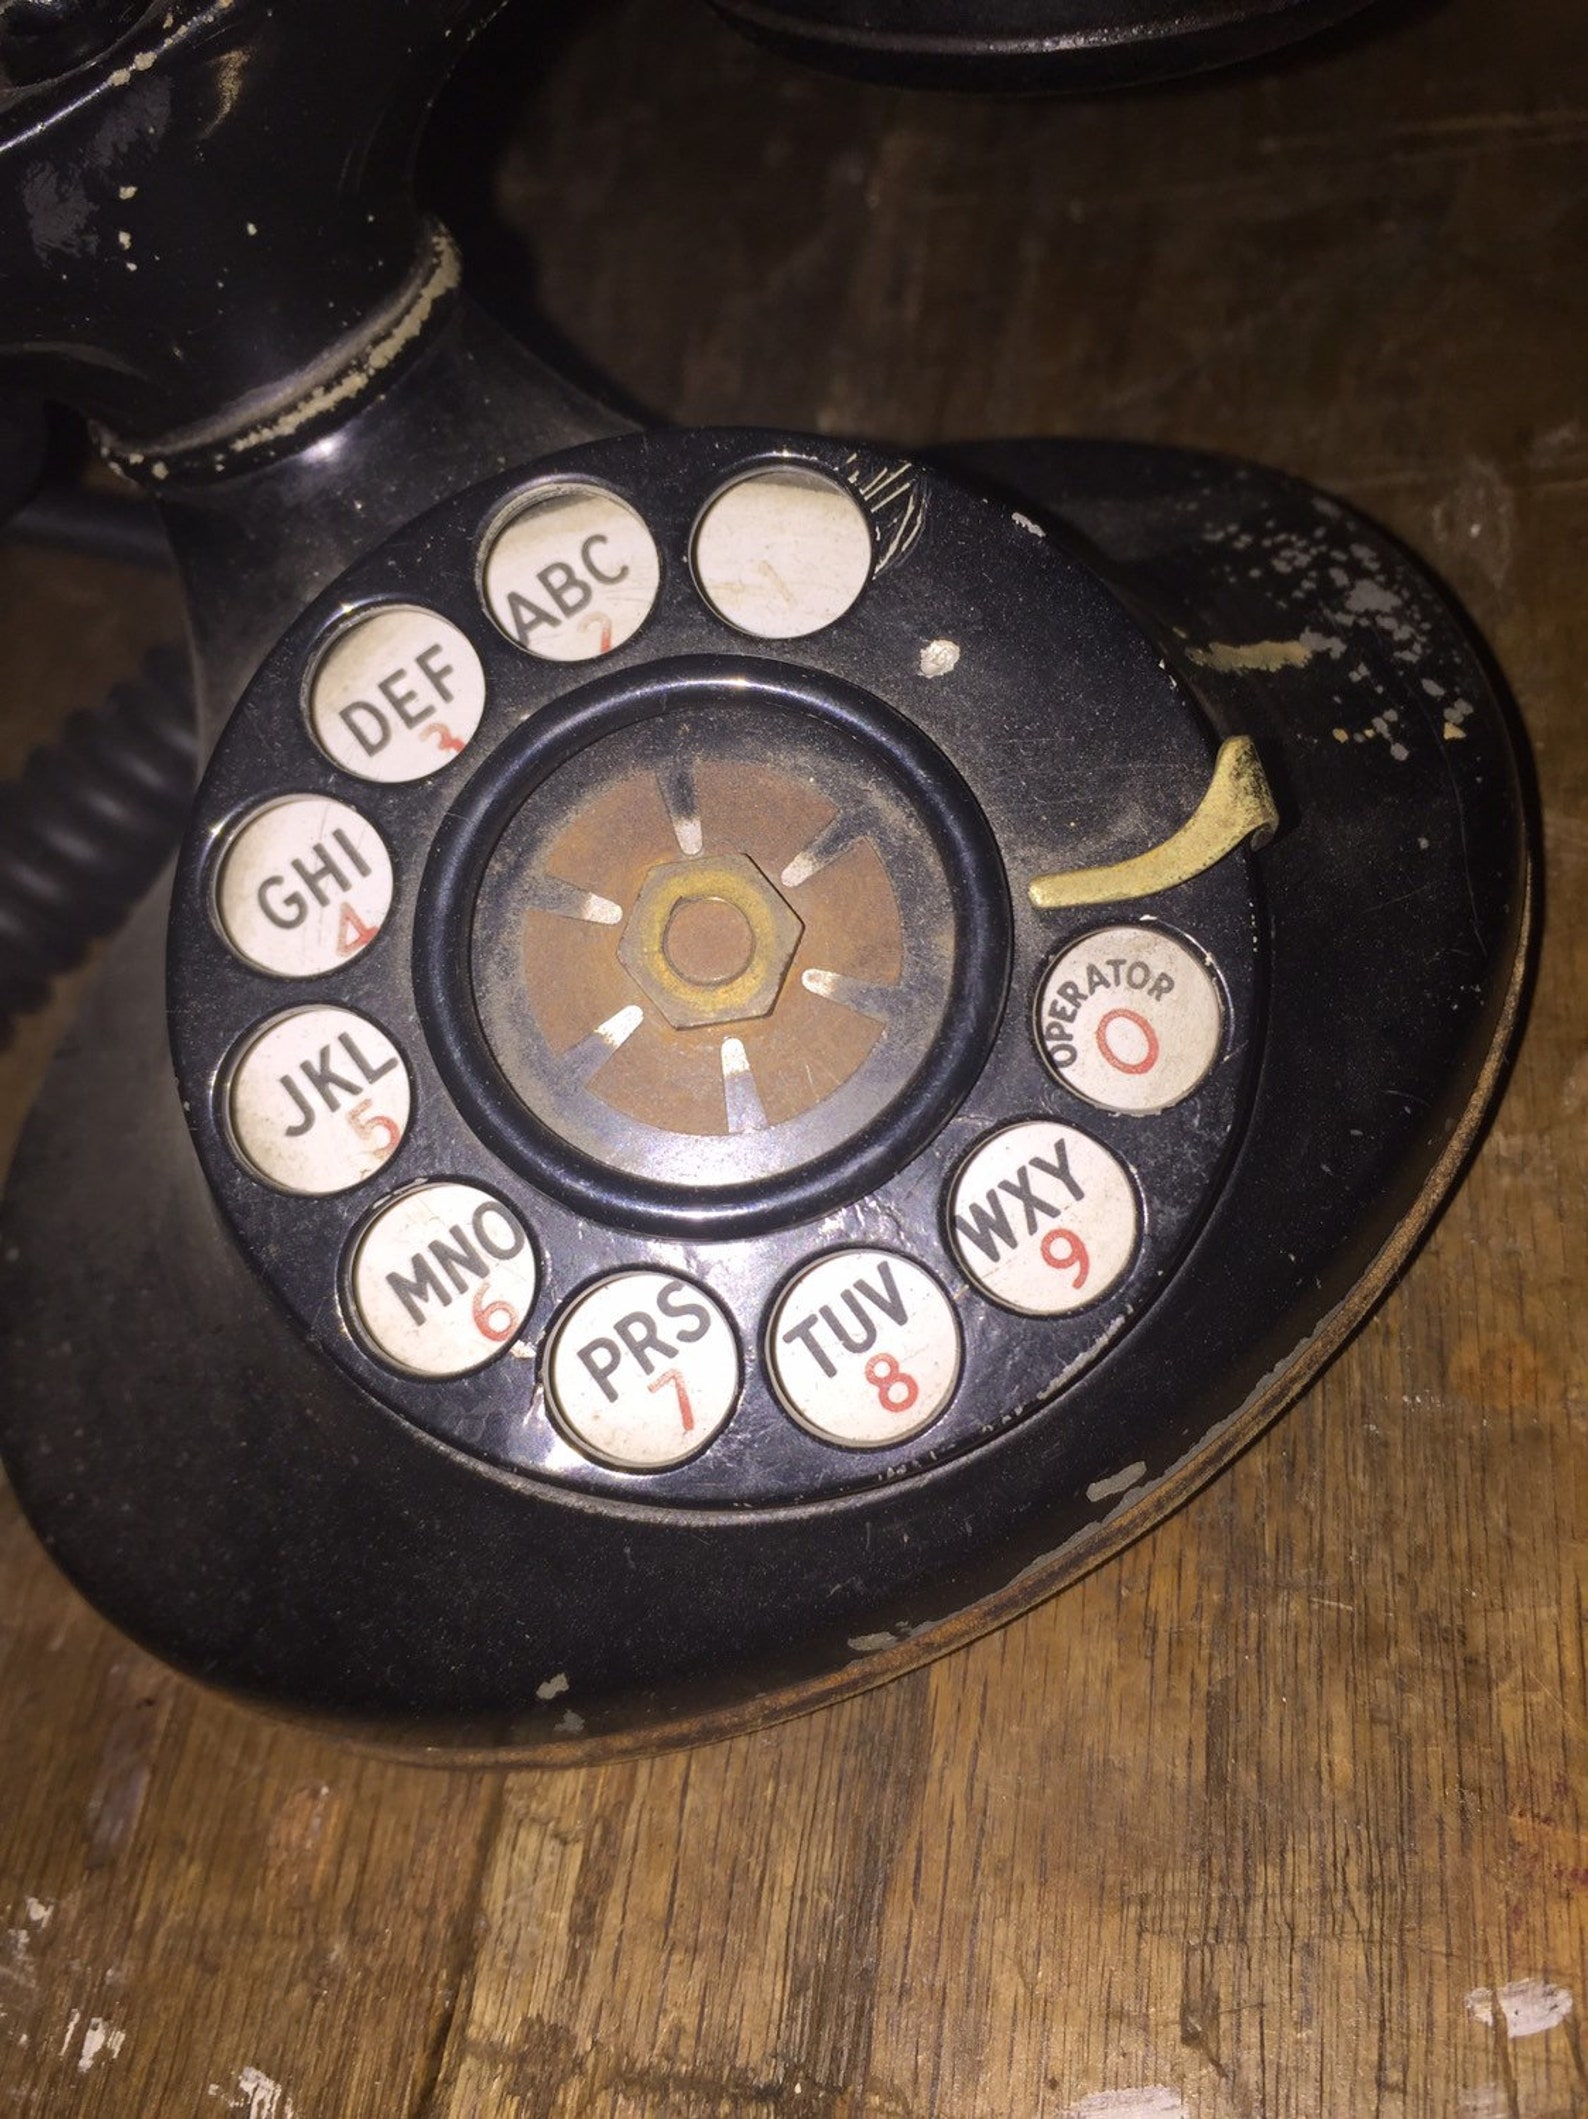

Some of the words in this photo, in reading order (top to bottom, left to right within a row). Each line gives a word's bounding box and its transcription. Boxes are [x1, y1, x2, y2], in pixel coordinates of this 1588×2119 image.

[507, 533, 630, 648] ABC
[339, 643, 454, 757] DEF
[257, 828, 372, 930] GHI
[335, 902, 379, 957] 4
[1045, 958, 1175, 1069] OPERATOR
[279, 1031, 399, 1137] JKL
[346, 1098, 401, 1160] 5
[955, 1137, 1085, 1263] WXY
[385, 1201, 525, 1326] MNO
[472, 1280, 518, 1342] 6
[1040, 1228, 1090, 1290] 9
[576, 1279, 711, 1403] PRS
[782, 1260, 908, 1378] TUV
[647, 1369, 695, 1431] 7
[865, 1353, 919, 1413] 8
